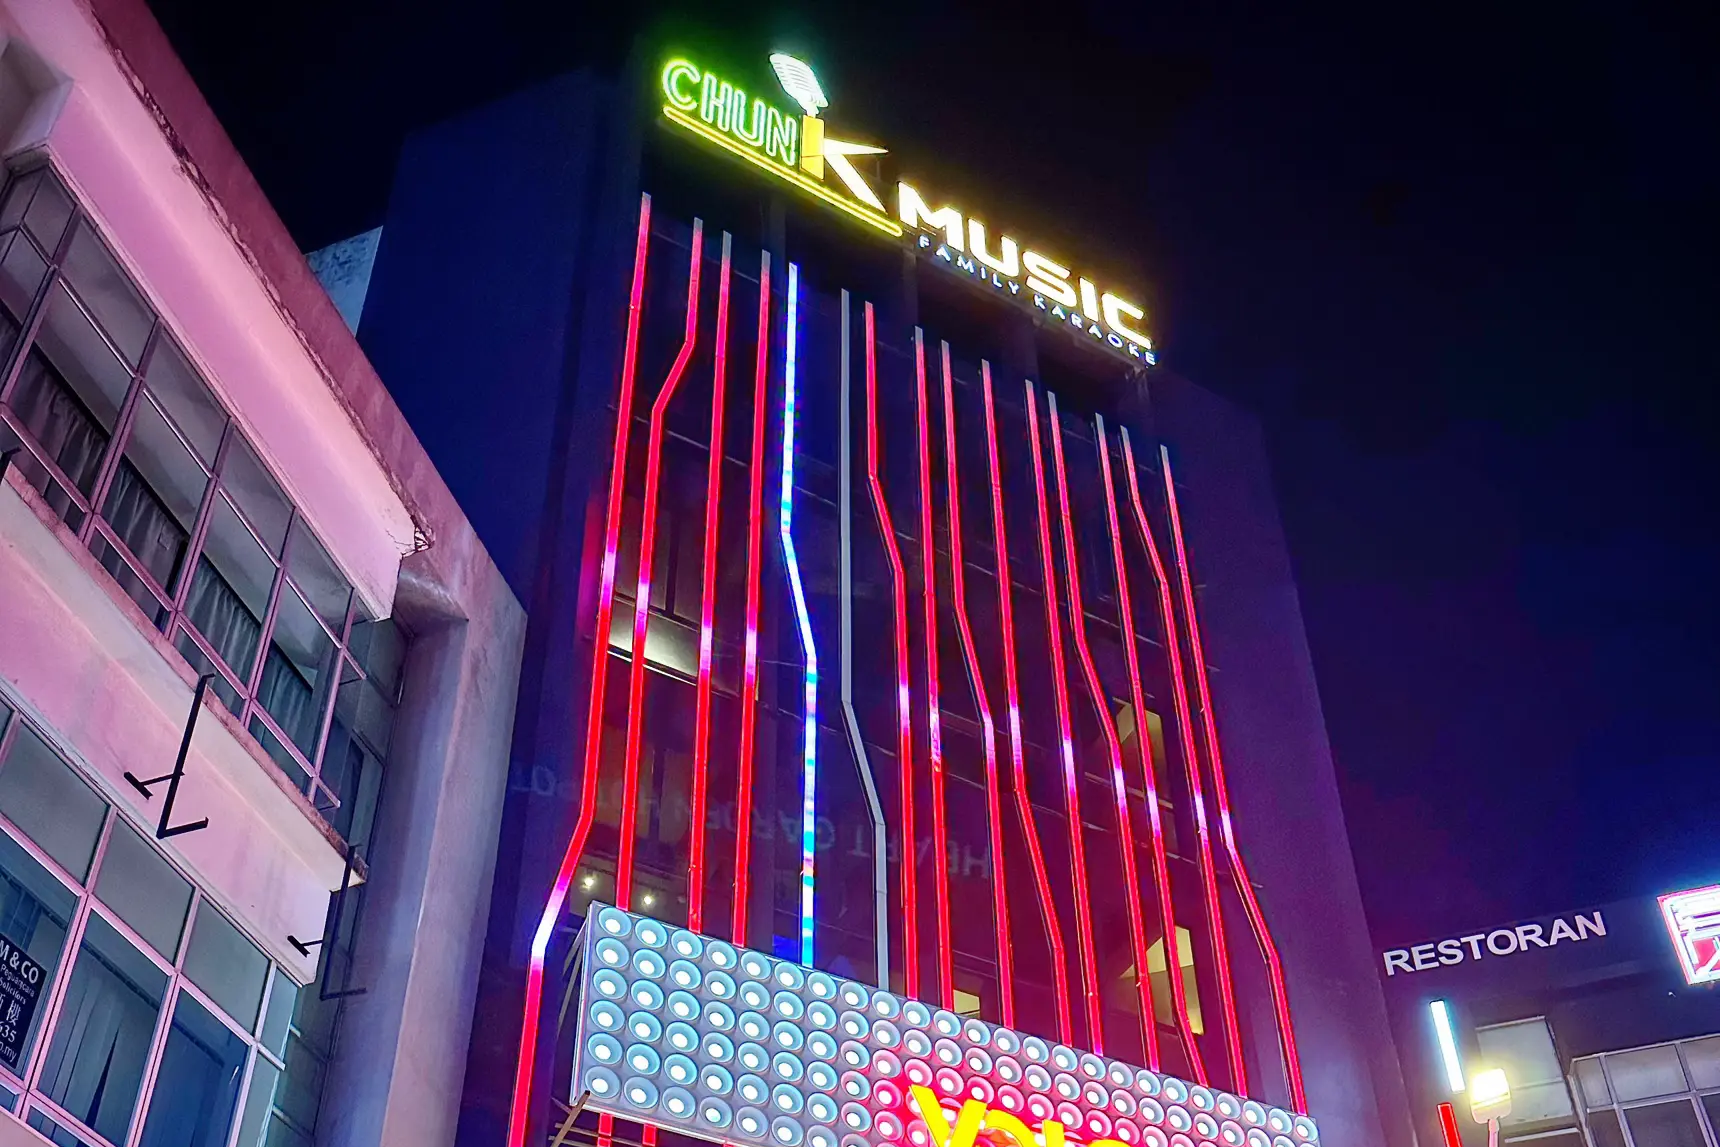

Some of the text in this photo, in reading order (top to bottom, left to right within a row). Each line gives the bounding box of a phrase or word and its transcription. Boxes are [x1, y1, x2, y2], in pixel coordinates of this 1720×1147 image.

[662, 57, 1152, 348] CHUN K MUSIC
[919, 235, 1156, 366] FAMILY KARAOKE
[10, 951, 20, 970] &
[21, 960, 39, 984] CO
[1383, 911, 1607, 976] RESTORAN
